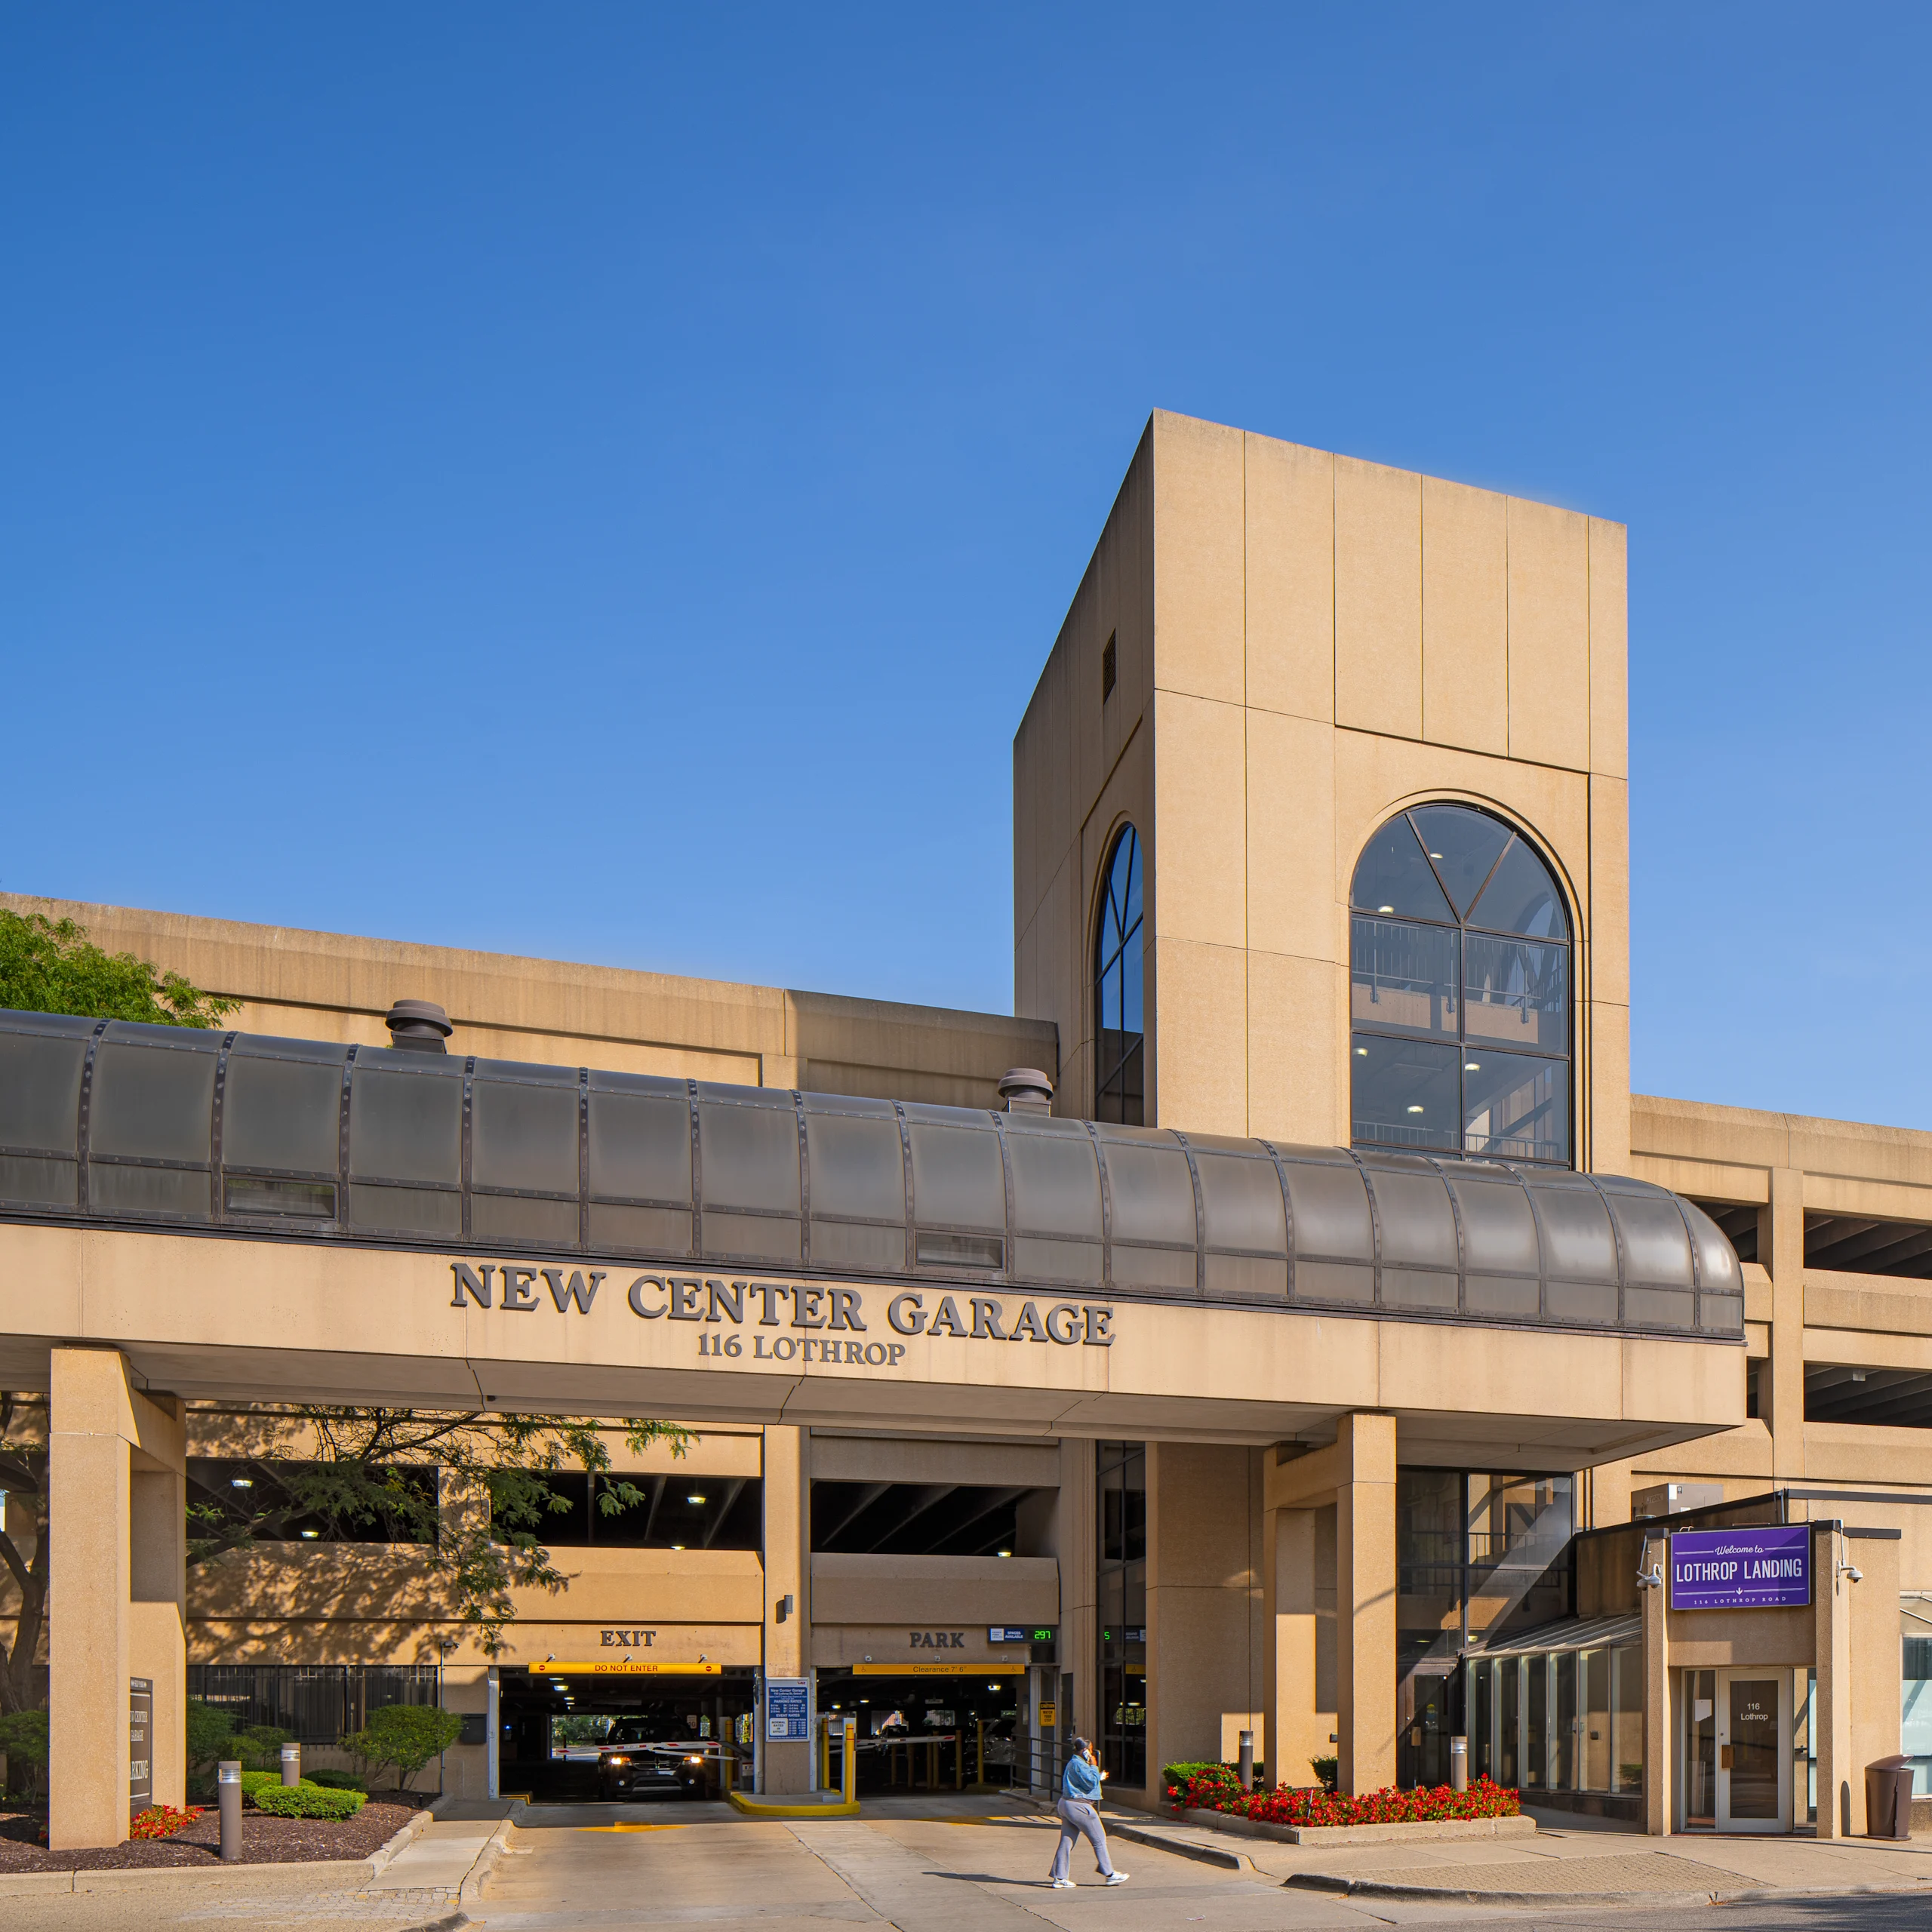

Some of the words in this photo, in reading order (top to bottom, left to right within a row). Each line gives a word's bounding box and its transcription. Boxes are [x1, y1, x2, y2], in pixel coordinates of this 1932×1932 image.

[450, 1263, 607, 1315] NEW
[628, 1275, 867, 1331] CENTER
[888, 1292, 1116, 1347] GARAGE
[698, 1333, 743, 1358] 116
[753, 1335, 906, 1366] LOTHROP
[1715, 1546, 1753, 1555] Welcome
[1754, 1545, 1764, 1553] to
[1676, 1561, 1738, 1582] LOTHROP
[1744, 1558, 1802, 1579] LANDING
[600, 1630, 657, 1646] EXIT
[909, 1632, 964, 1648] PARK
[1035, 1631, 1051, 1639] 297
[1740, 1713, 1768, 1721] Lothrop
